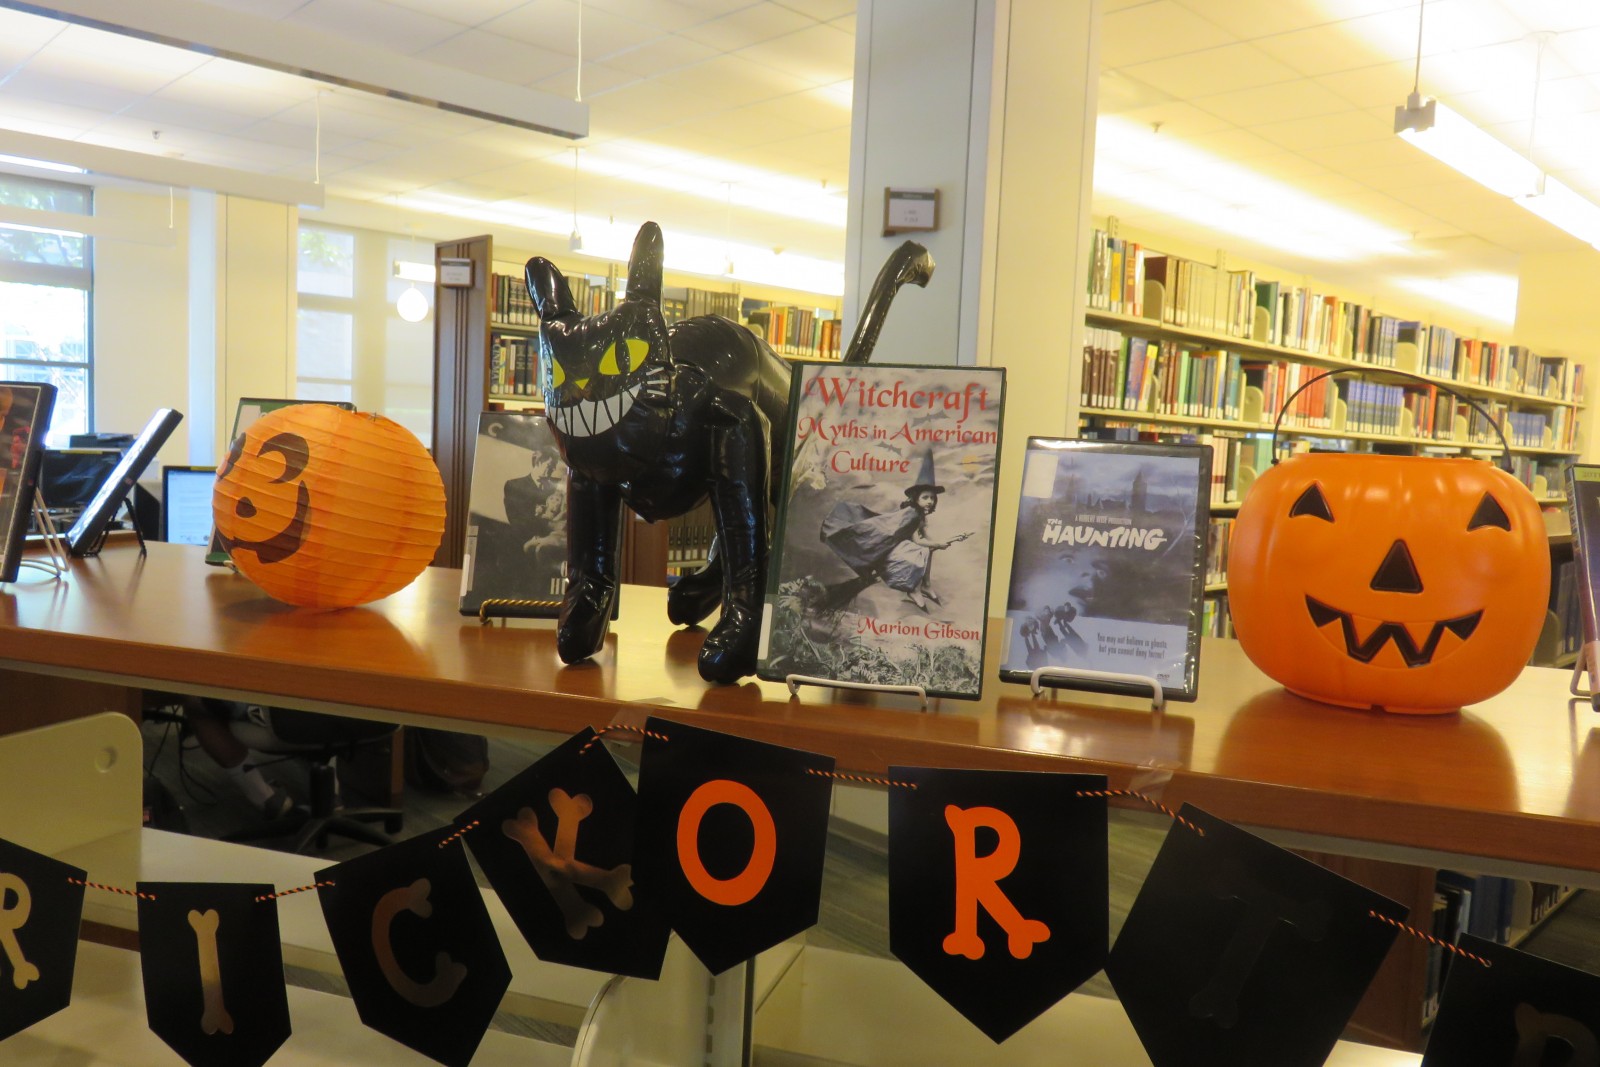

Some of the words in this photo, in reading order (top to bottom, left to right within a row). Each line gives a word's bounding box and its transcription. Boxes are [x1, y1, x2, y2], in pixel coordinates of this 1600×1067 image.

[805, 376, 988, 424] Witchcraft
[797, 416, 868, 446] Myths
[873, 425, 887, 439] in
[890, 422, 997, 445] American
[831, 450, 911, 474] Culture
[1042, 524, 1168, 550] HAUNTING
[857, 615, 920, 637] Marion
[924, 622, 980, 641] Gibson
